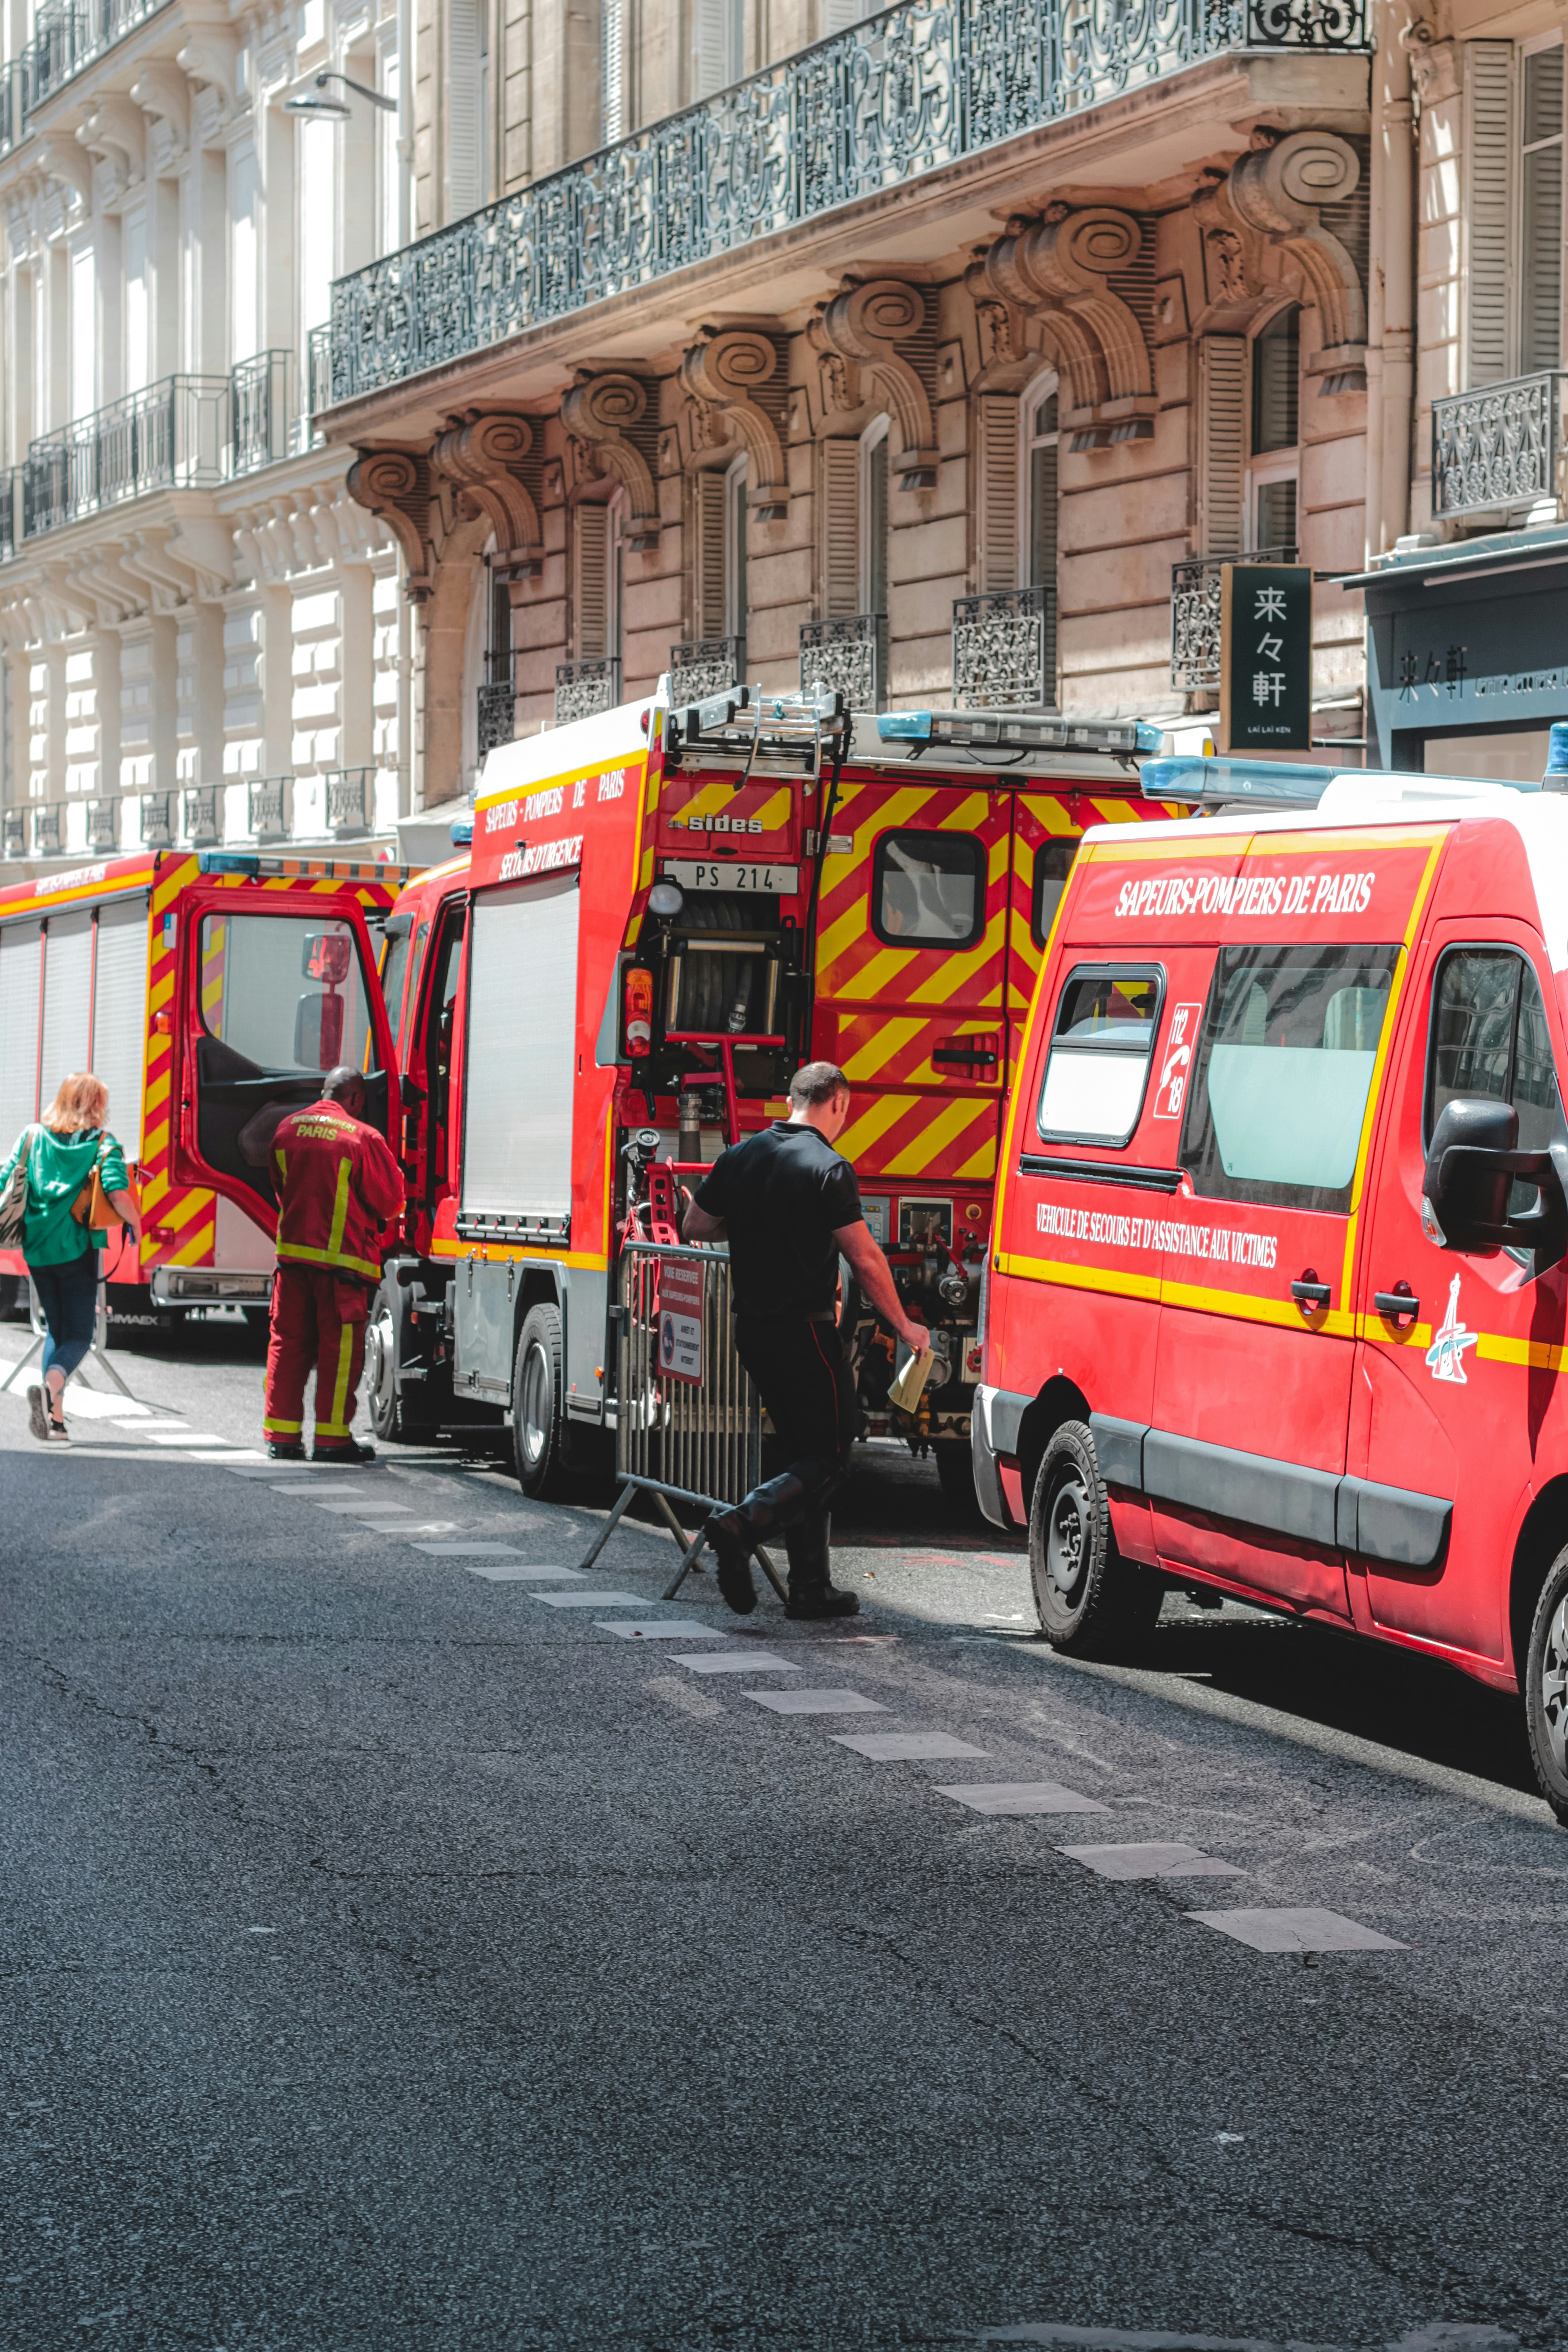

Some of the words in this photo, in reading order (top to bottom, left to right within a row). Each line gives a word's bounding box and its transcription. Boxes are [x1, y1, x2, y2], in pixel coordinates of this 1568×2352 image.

[1253, 586, 1287, 707] 来々軒
[572, 779, 587, 809] DE
[597, 768, 625, 802] PARIS
[688, 813, 763, 834] sides
[696, 866, 719, 887] PS
[737, 867, 773, 889] 214
[1115, 876, 1285, 916] SAPEURS-POMPIERS
[1282, 876, 1316, 914] DE
[1311, 872, 1375, 913] PARIS
[1171, 1009, 1189, 1044] 112
[1168, 1076, 1184, 1113] 18
[296, 1124, 338, 1141] PARIS
[1036, 1203, 1077, 1238] VEHICULE
[1076, 1210, 1090, 1240] DE
[1089, 1212, 1130, 1246] SECOURS
[1130, 1218, 1143, 1248] ET
[1142, 1218, 1210, 1258] D'ASSISTANCE
[1209, 1228, 1231, 1261] AUX
[1231, 1231, 1277, 1269] VICTIMES
